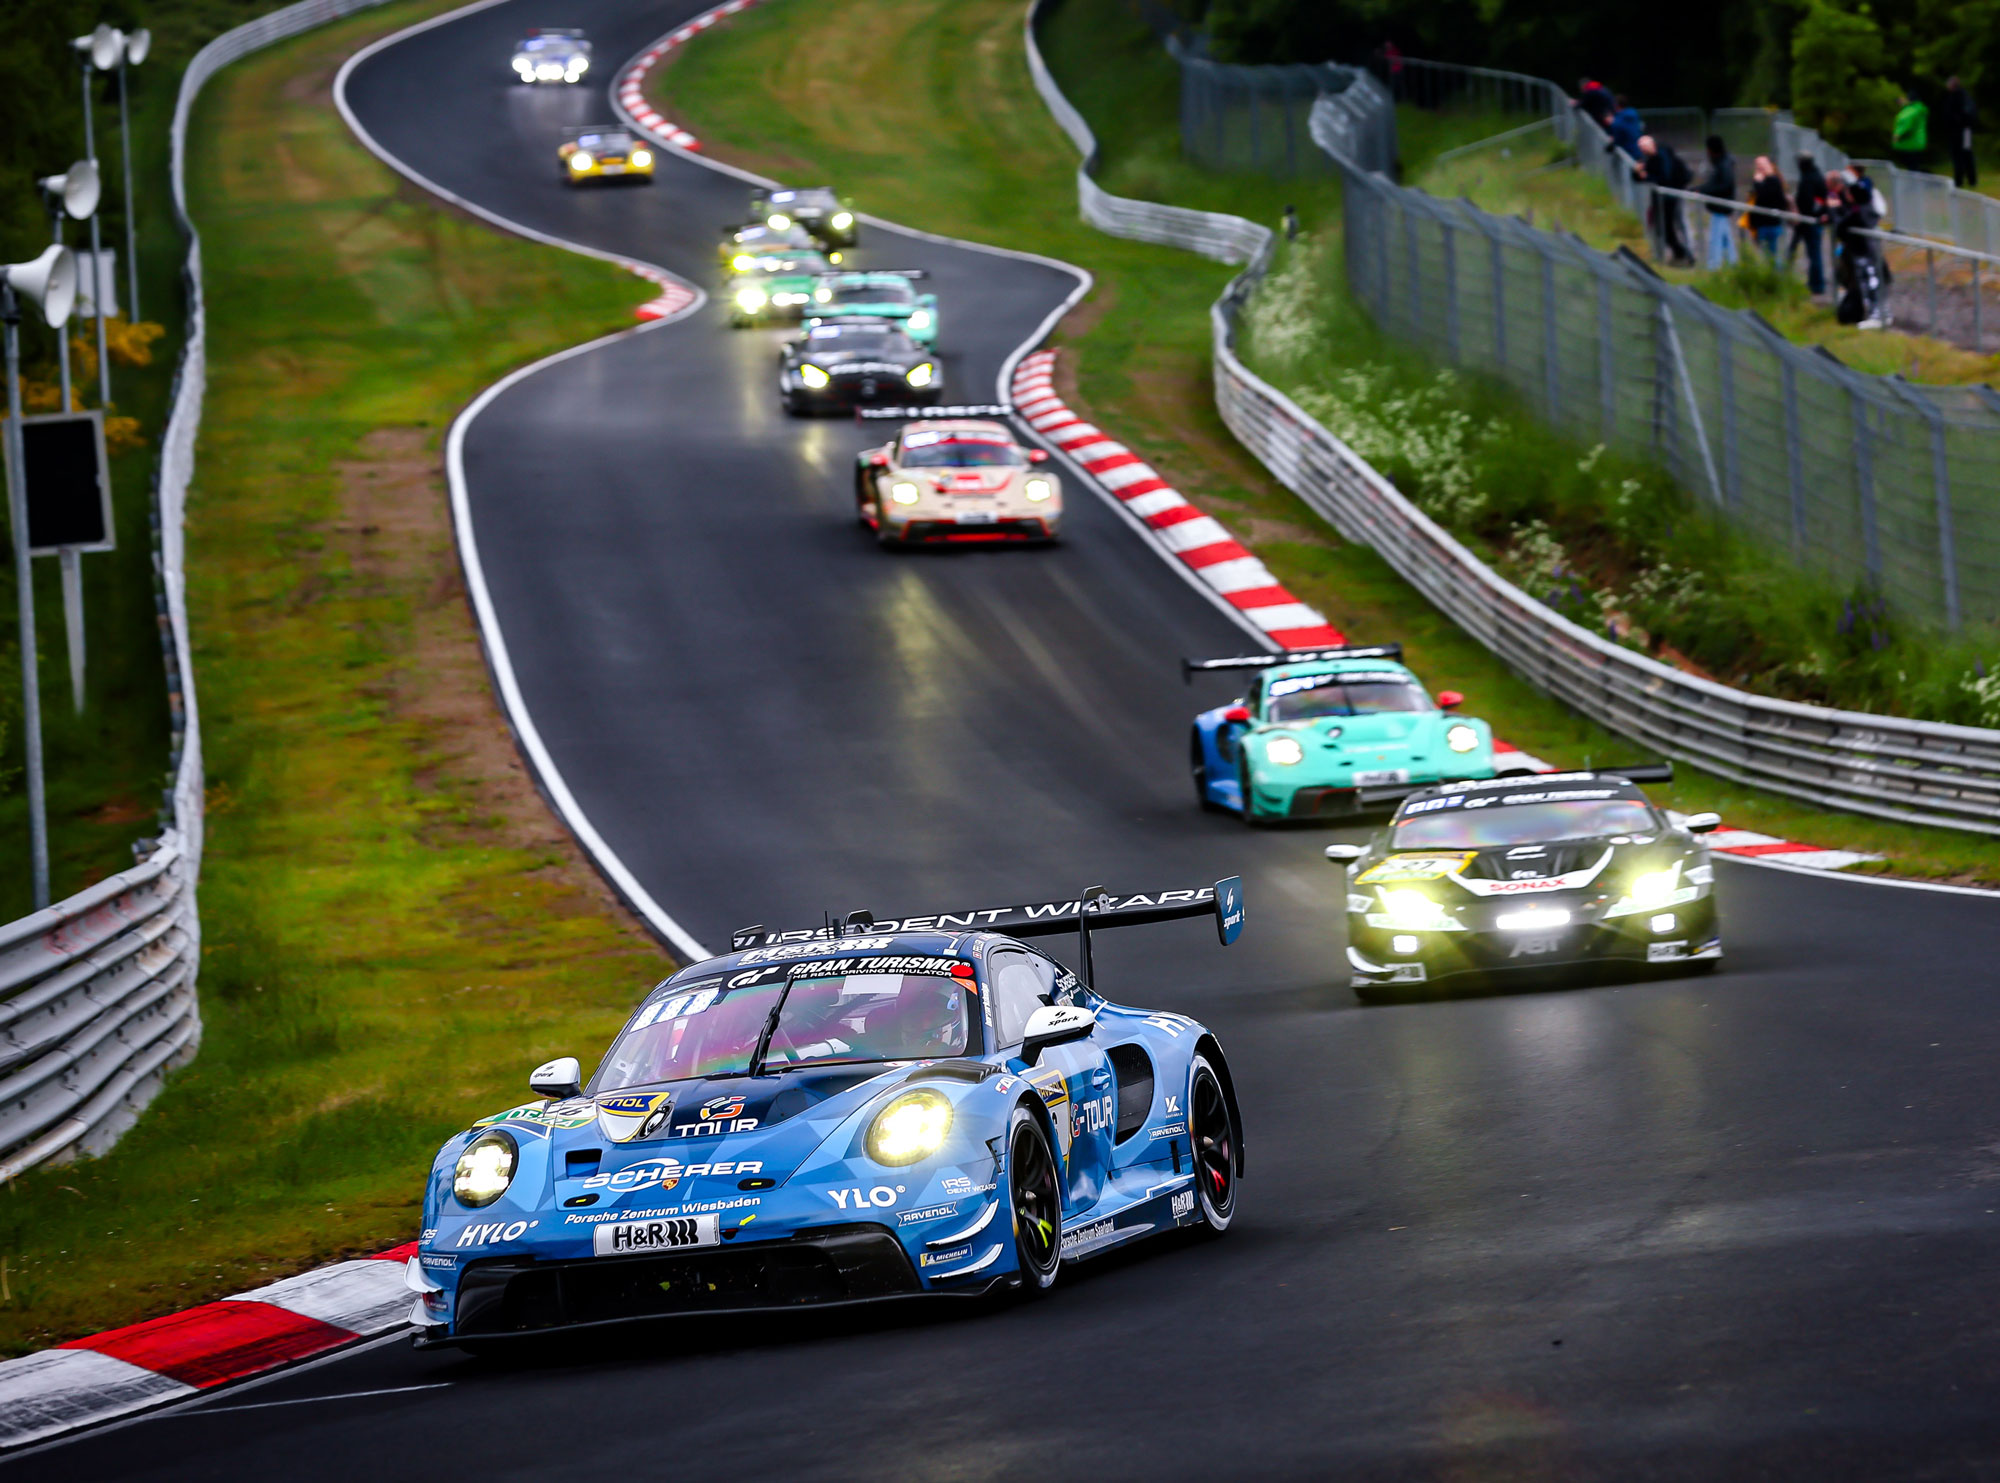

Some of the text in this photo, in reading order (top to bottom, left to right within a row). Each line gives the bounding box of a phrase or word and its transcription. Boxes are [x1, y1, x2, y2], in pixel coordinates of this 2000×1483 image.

[1490, 877, 1566, 892] SONAX
[1223, 911, 1241, 930] spark
[787, 956, 960, 976] GRAN TURISMO
[840, 968, 886, 976] DRIVING
[888, 968, 953, 977] SIMULATOR
[1047, 1014, 1080, 1027] spark
[675, 1118, 759, 1138] TOUR
[1151, 1124, 1183, 1138] RAVENOL
[582, 1161, 764, 1189] SCHERER
[941, 1177, 971, 1189] IRS
[946, 1183, 997, 1195] DENT WIZARD
[564, 1197, 761, 1225] Porsche Zentrum Wiesbaden
[903, 1206, 954, 1223] RAVENOL
[456, 1221, 528, 1248] HYLO
[1077, 1224, 1096, 1244] Zentrum
[936, 1248, 968, 1261] MICHELIN
